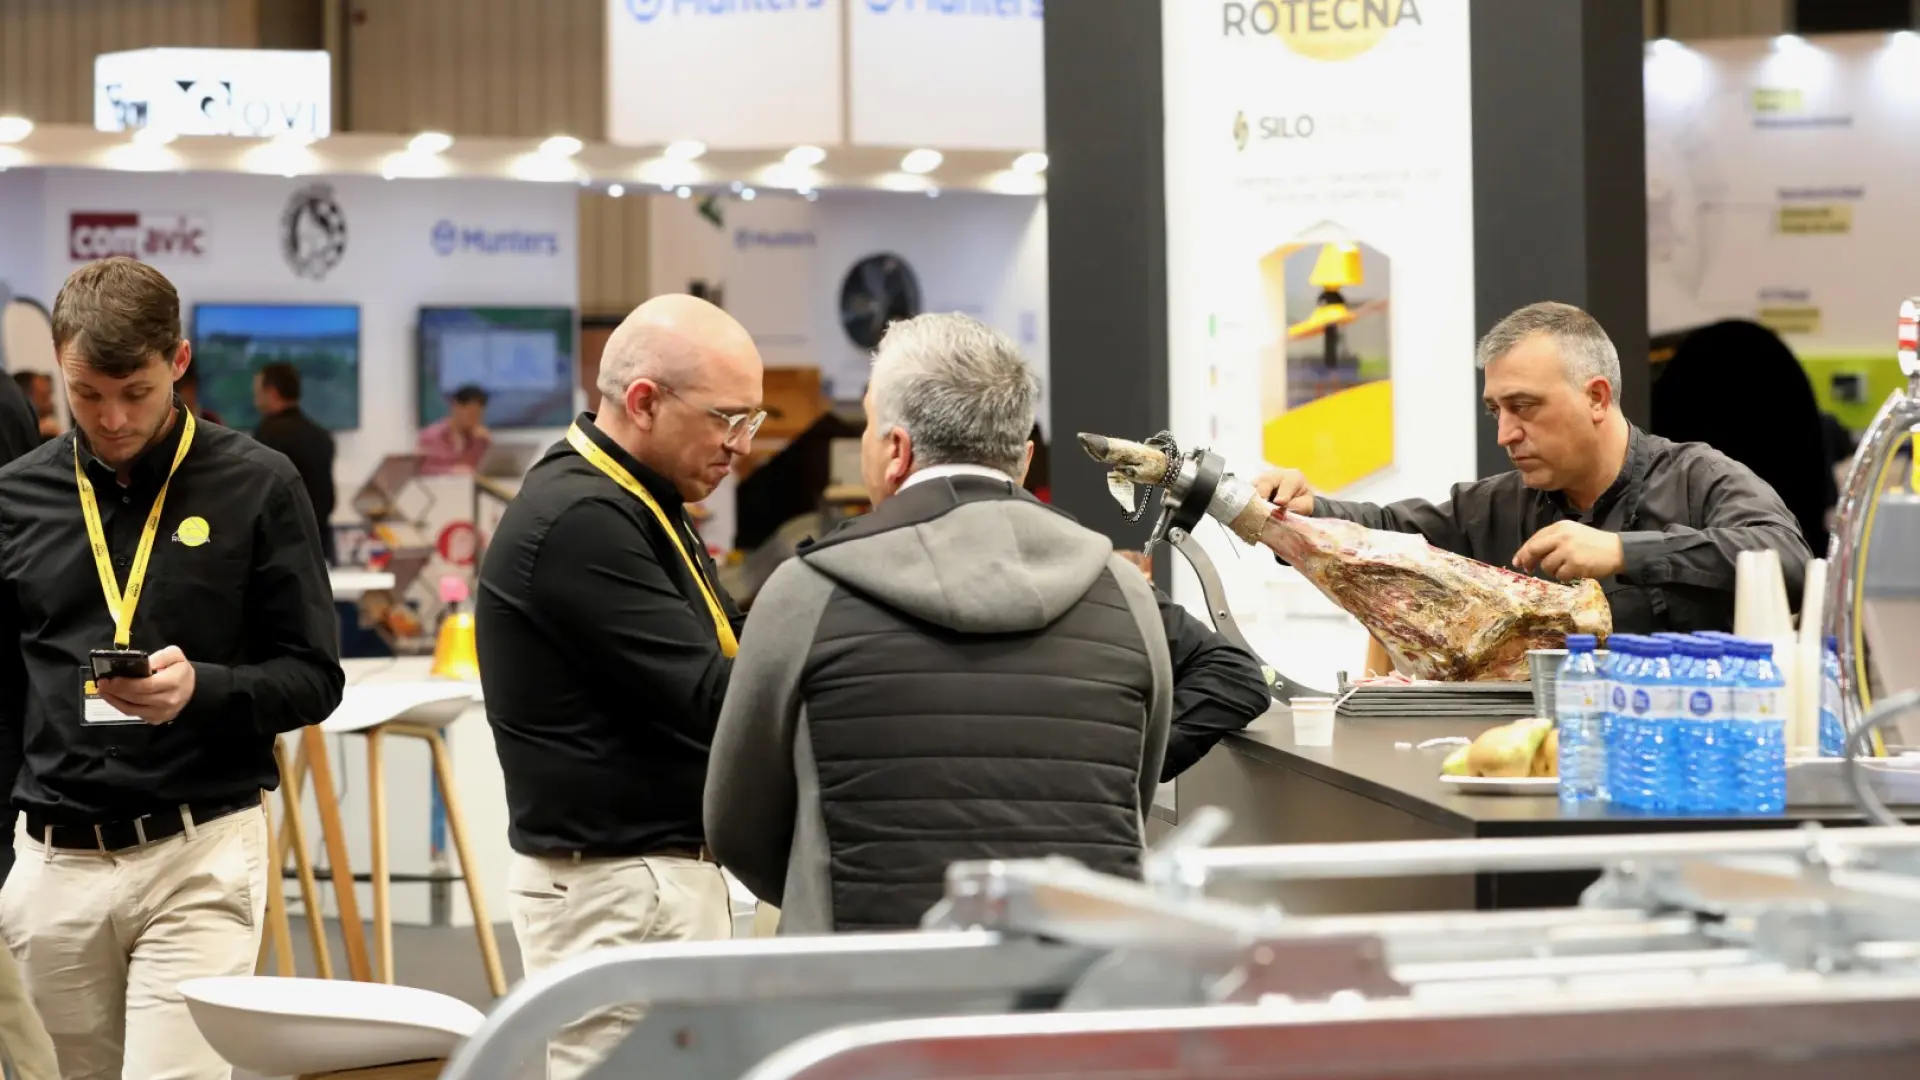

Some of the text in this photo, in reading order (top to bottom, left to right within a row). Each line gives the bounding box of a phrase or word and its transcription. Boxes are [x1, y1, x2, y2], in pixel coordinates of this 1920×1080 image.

[1222, 0, 1423, 36] ROTECNA
[1258, 113, 1316, 139] SILO
[460, 226, 559, 255] Munters
